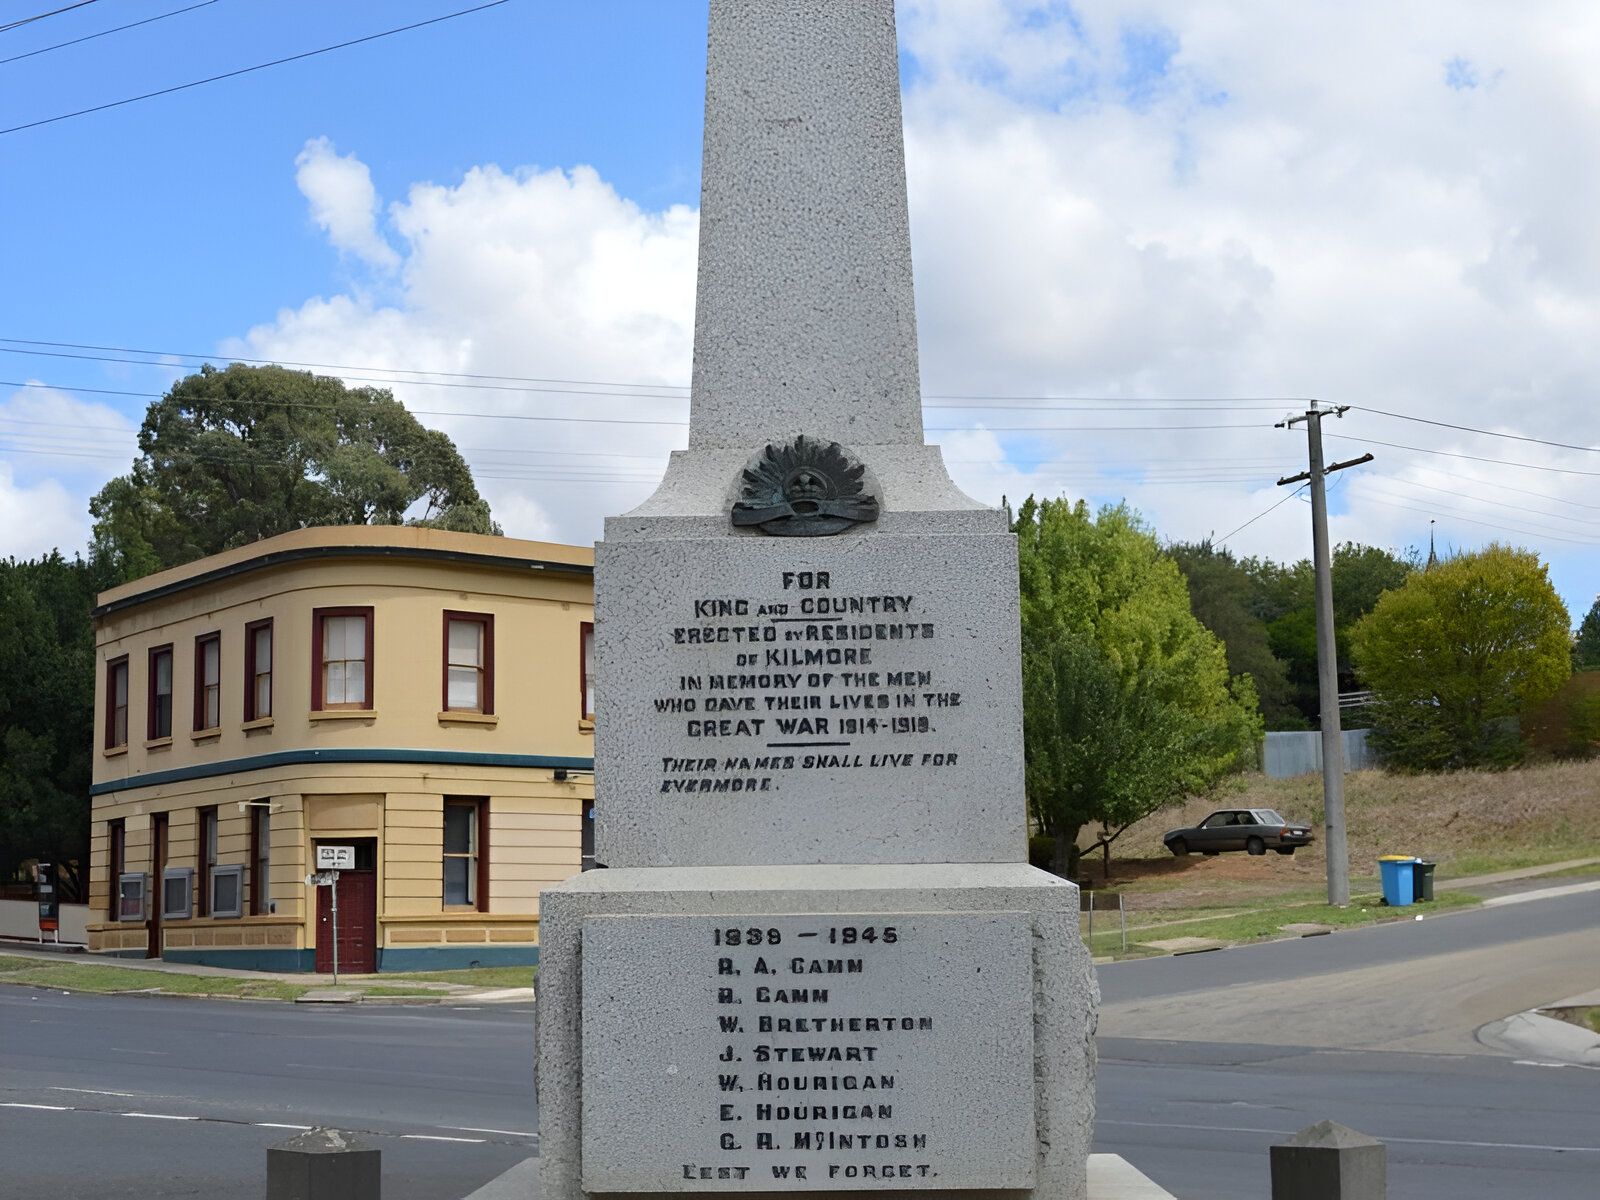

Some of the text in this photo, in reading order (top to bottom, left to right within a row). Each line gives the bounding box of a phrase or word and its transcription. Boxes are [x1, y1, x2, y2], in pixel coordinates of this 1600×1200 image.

[782, 571, 830, 590] FOR
[694, 595, 913, 618] KING AND COUNTRY
[674, 623, 934, 644] ERECTED BY RESIDENTS
[736, 648, 872, 667] OF KILMORE
[680, 670, 931, 690] IN MEMORY OF THE MEN
[654, 691, 961, 713] WHO GAVE THEIR LIVES IN THE
[687, 718, 765, 738] GREAT
[775, 717, 829, 736] WAR
[661, 753, 958, 773] THEIR NAMES SHALL LIVE FOR
[660, 778, 780, 794] EVERMORE.
[714, 928, 782, 946] 1939
[829, 926, 898, 944] 1945
[753, 956, 777, 975] A.
[718, 1015, 933, 1033] W. BRETHERTON
[719, 1045, 878, 1062] J. STEWART
[718, 1072, 895, 1092] W. HOURIGAN
[720, 1103, 893, 1121] E. HOURIGAN
[682, 1163, 939, 1180] LEST WE FORGET.
